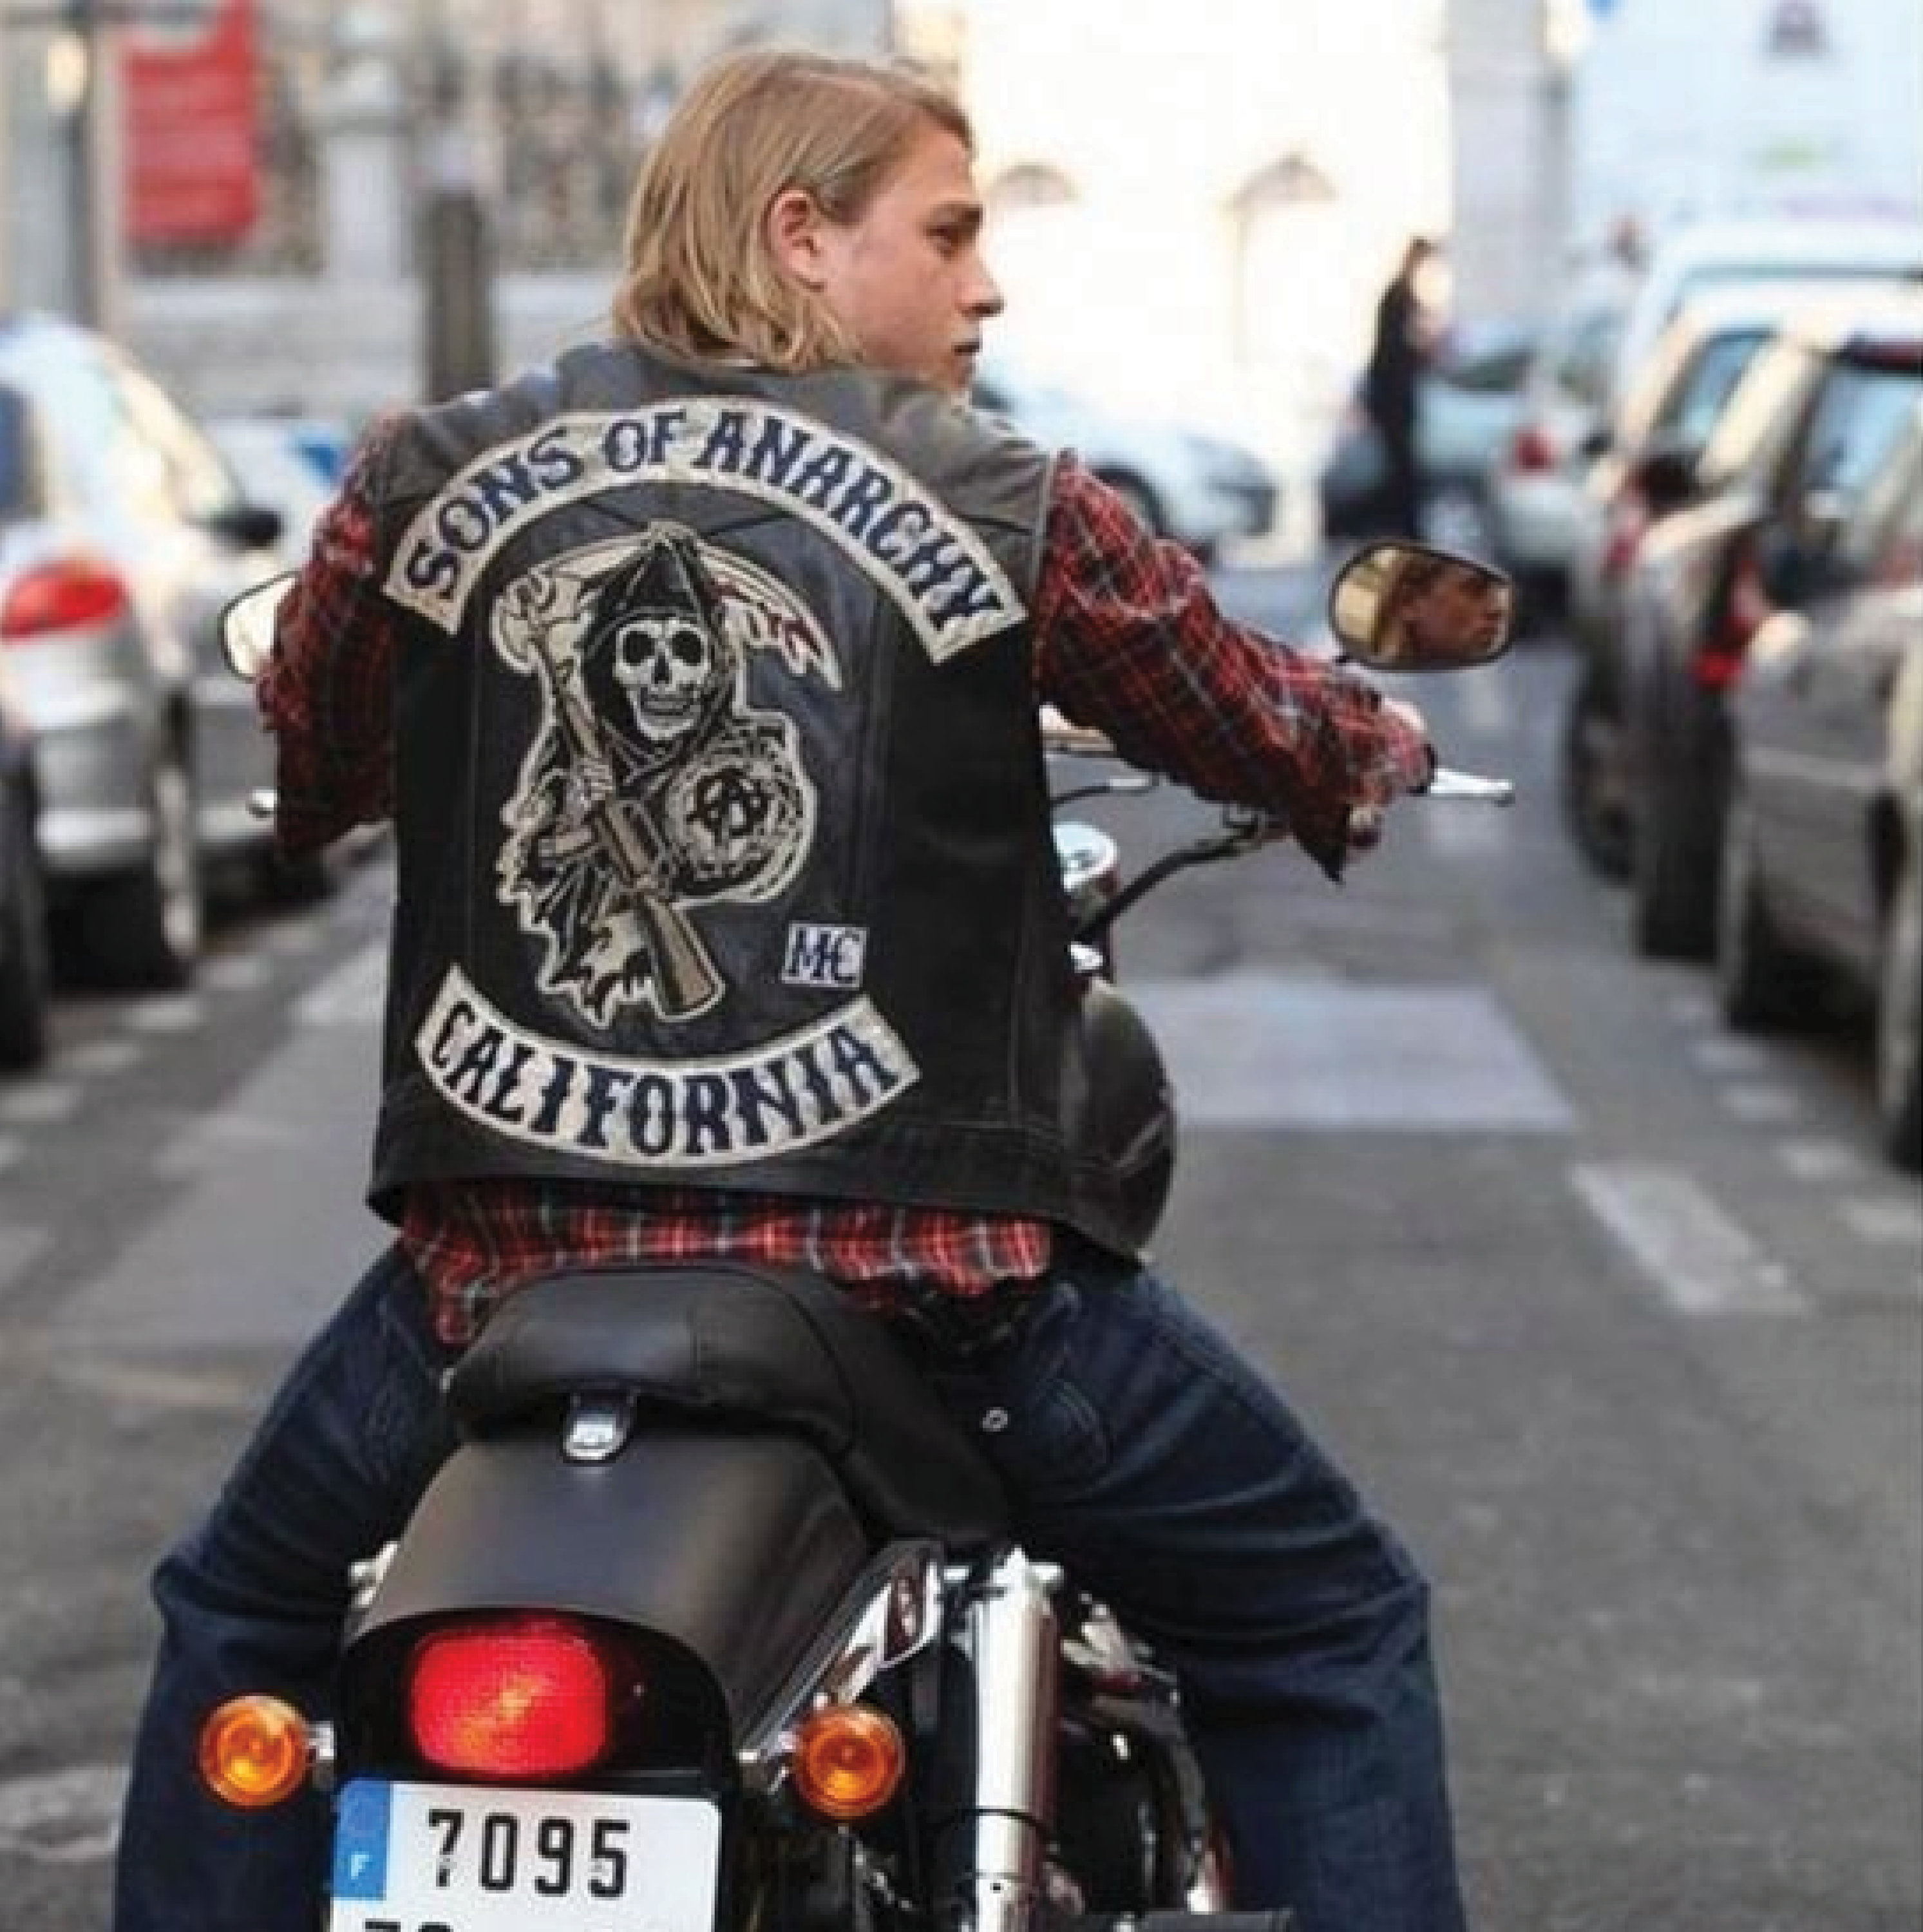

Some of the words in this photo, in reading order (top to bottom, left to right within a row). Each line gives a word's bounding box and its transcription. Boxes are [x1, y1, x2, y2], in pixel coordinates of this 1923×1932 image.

[406, 428, 585, 603] SONS
[602, 411, 687, 473] OF
[691, 410, 1003, 632] ANARCHY
[787, 927, 862, 983] MC
[430, 1001, 903, 1158] CALIFORNIA
[350, 1852, 368, 1880] F
[428, 1808, 631, 1899] 7095
